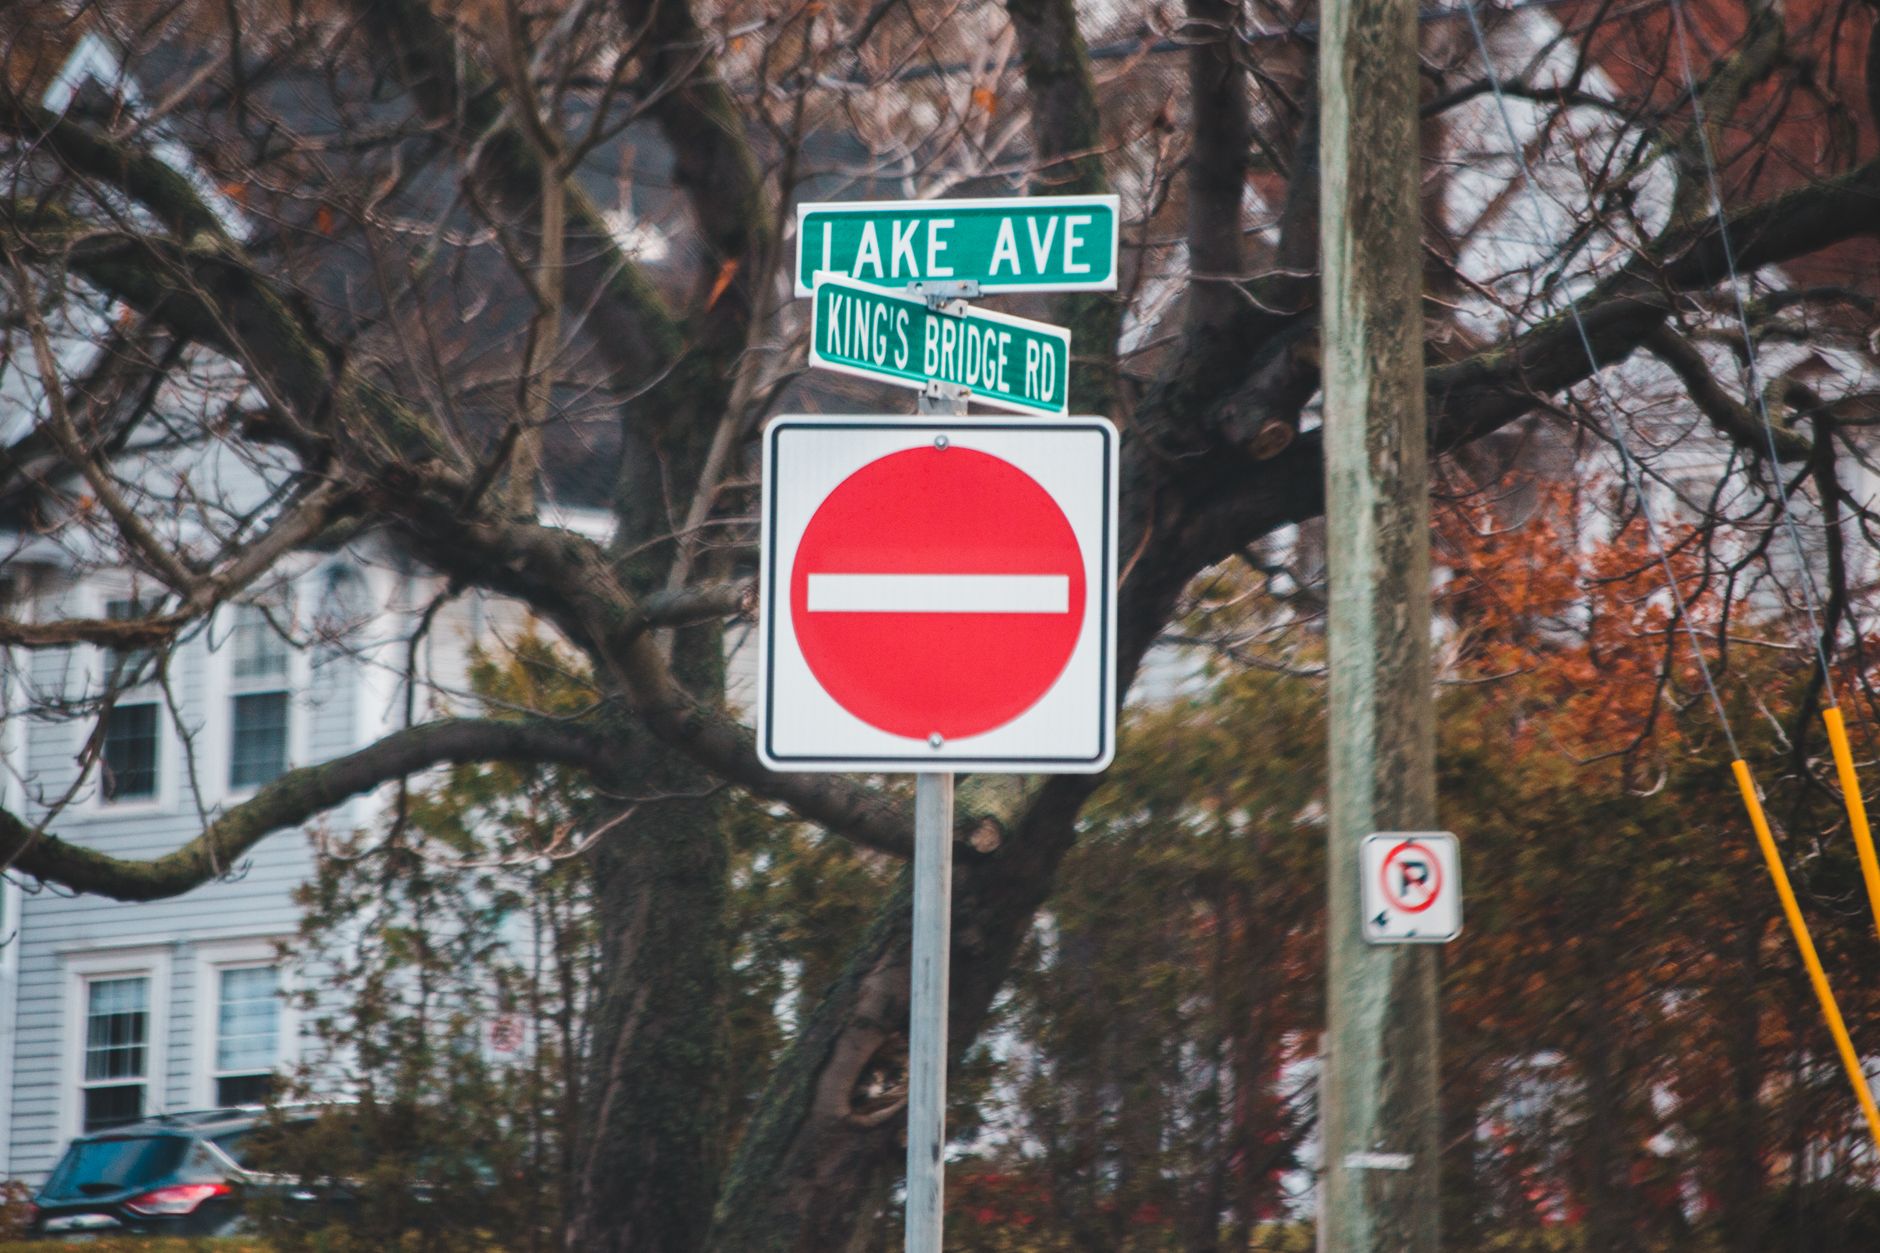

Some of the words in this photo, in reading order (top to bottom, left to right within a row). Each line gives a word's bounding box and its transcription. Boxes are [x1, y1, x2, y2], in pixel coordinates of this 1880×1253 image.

[821, 218, 955, 279] LAKE
[988, 215, 1092, 276] AVE
[827, 292, 909, 370] KING'S
[923, 315, 1012, 393] BRIDGE
[1025, 338, 1056, 402] RD
[1399, 861, 1428, 897] P
